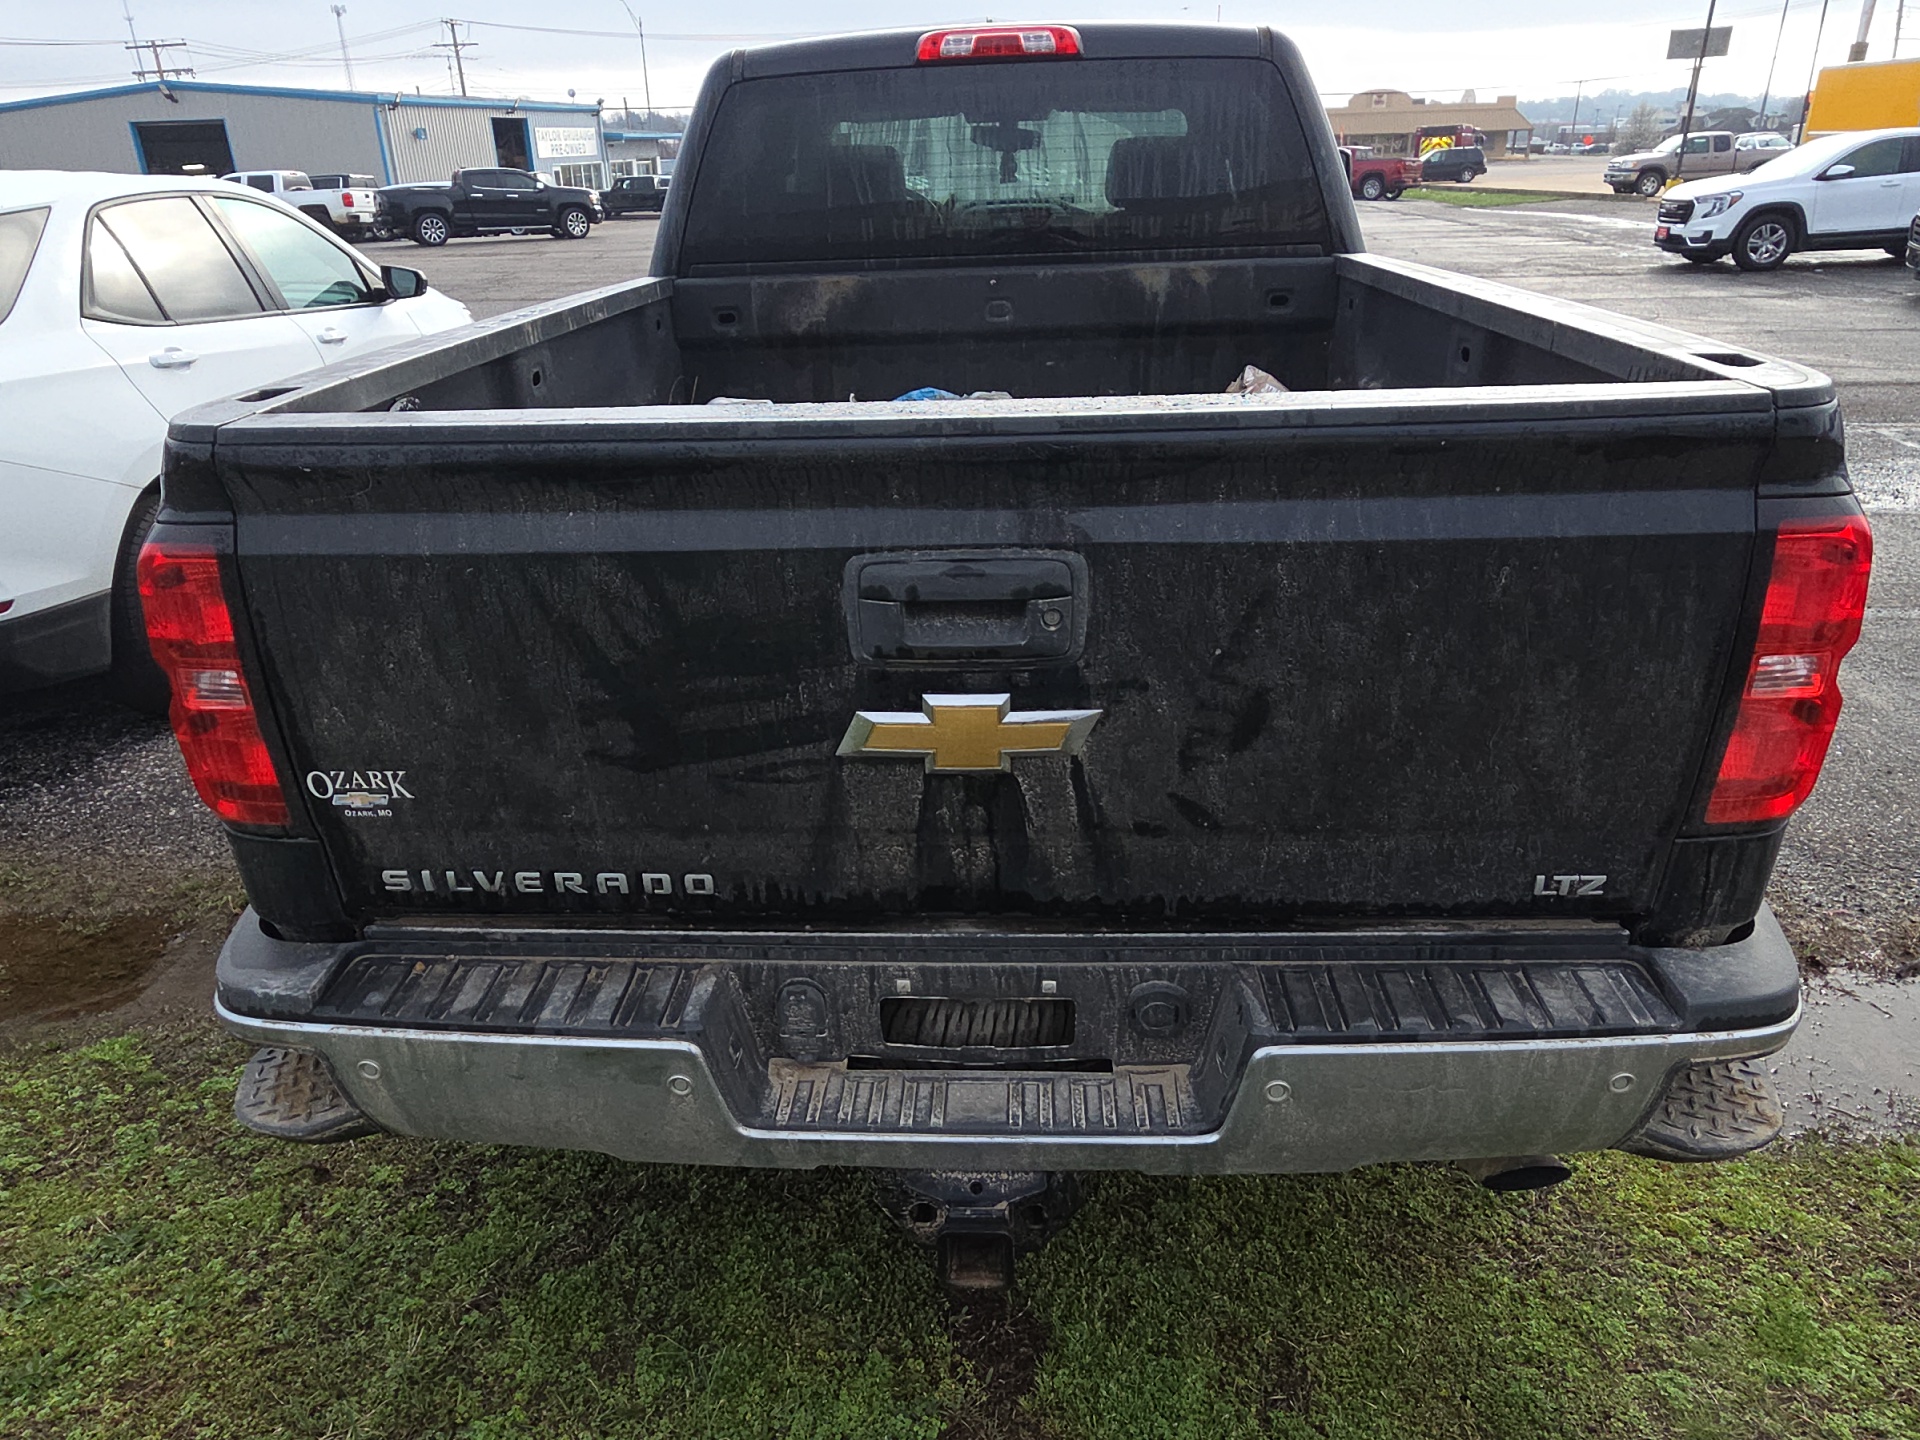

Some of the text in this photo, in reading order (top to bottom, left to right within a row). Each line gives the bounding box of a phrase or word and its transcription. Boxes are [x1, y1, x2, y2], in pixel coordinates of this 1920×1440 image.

[537, 129, 562, 142] TAYLOR
[550, 143, 587, 156] PRE-OWNED
[306, 770, 416, 799] OZARK
[377, 809, 393, 817] MO
[381, 869, 716, 895] SILVERADO
[1533, 874, 1608, 896] LTZ
